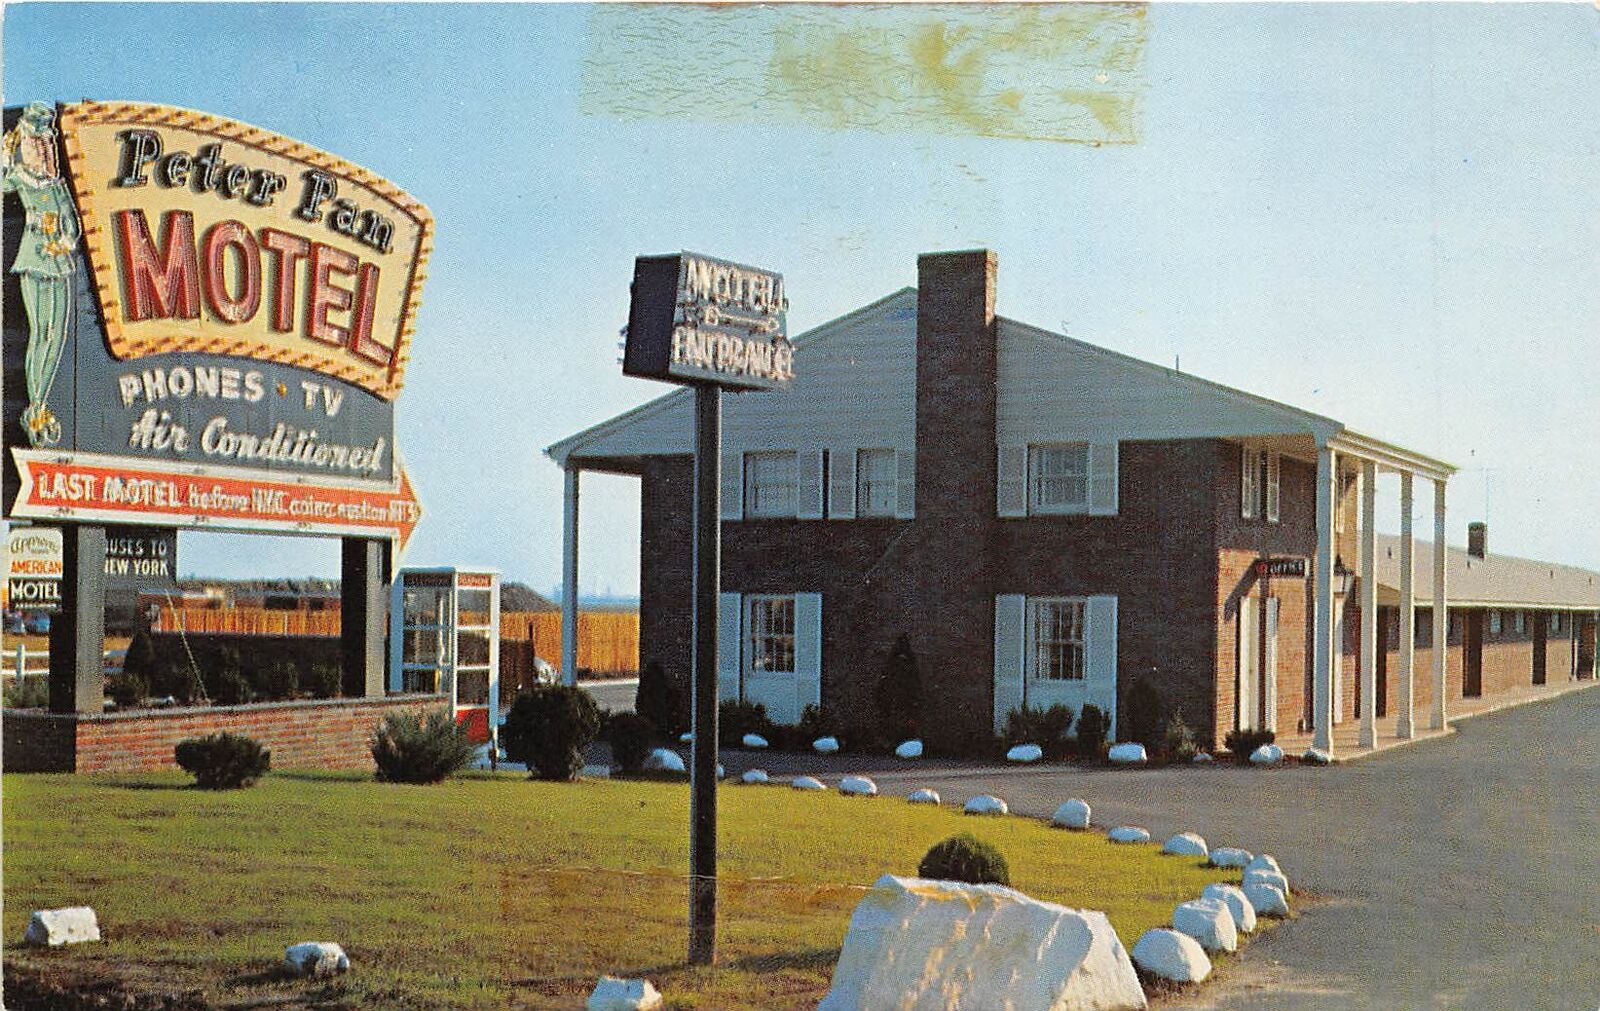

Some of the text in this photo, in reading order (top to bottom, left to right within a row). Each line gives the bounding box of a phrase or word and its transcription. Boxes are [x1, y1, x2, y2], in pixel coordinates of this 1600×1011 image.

[108, 129, 396, 255] Peter Pan
[111, 208, 397, 367] MOTEL
[684, 258, 786, 313] MOTEL
[671, 326, 795, 380] ENTRANCE
[119, 366, 343, 416] PHONES TV
[129, 407, 385, 472] Air Conditioned
[38, 471, 95, 500] LAST
[103, 476, 182, 507] MOTEL
[190, 483, 250, 511] before
[11, 560, 62, 575] AMERICAN
[133, 559, 168, 576] YORK
[151, 539, 167, 556] TO
[11, 580, 62, 600] MOTEL
